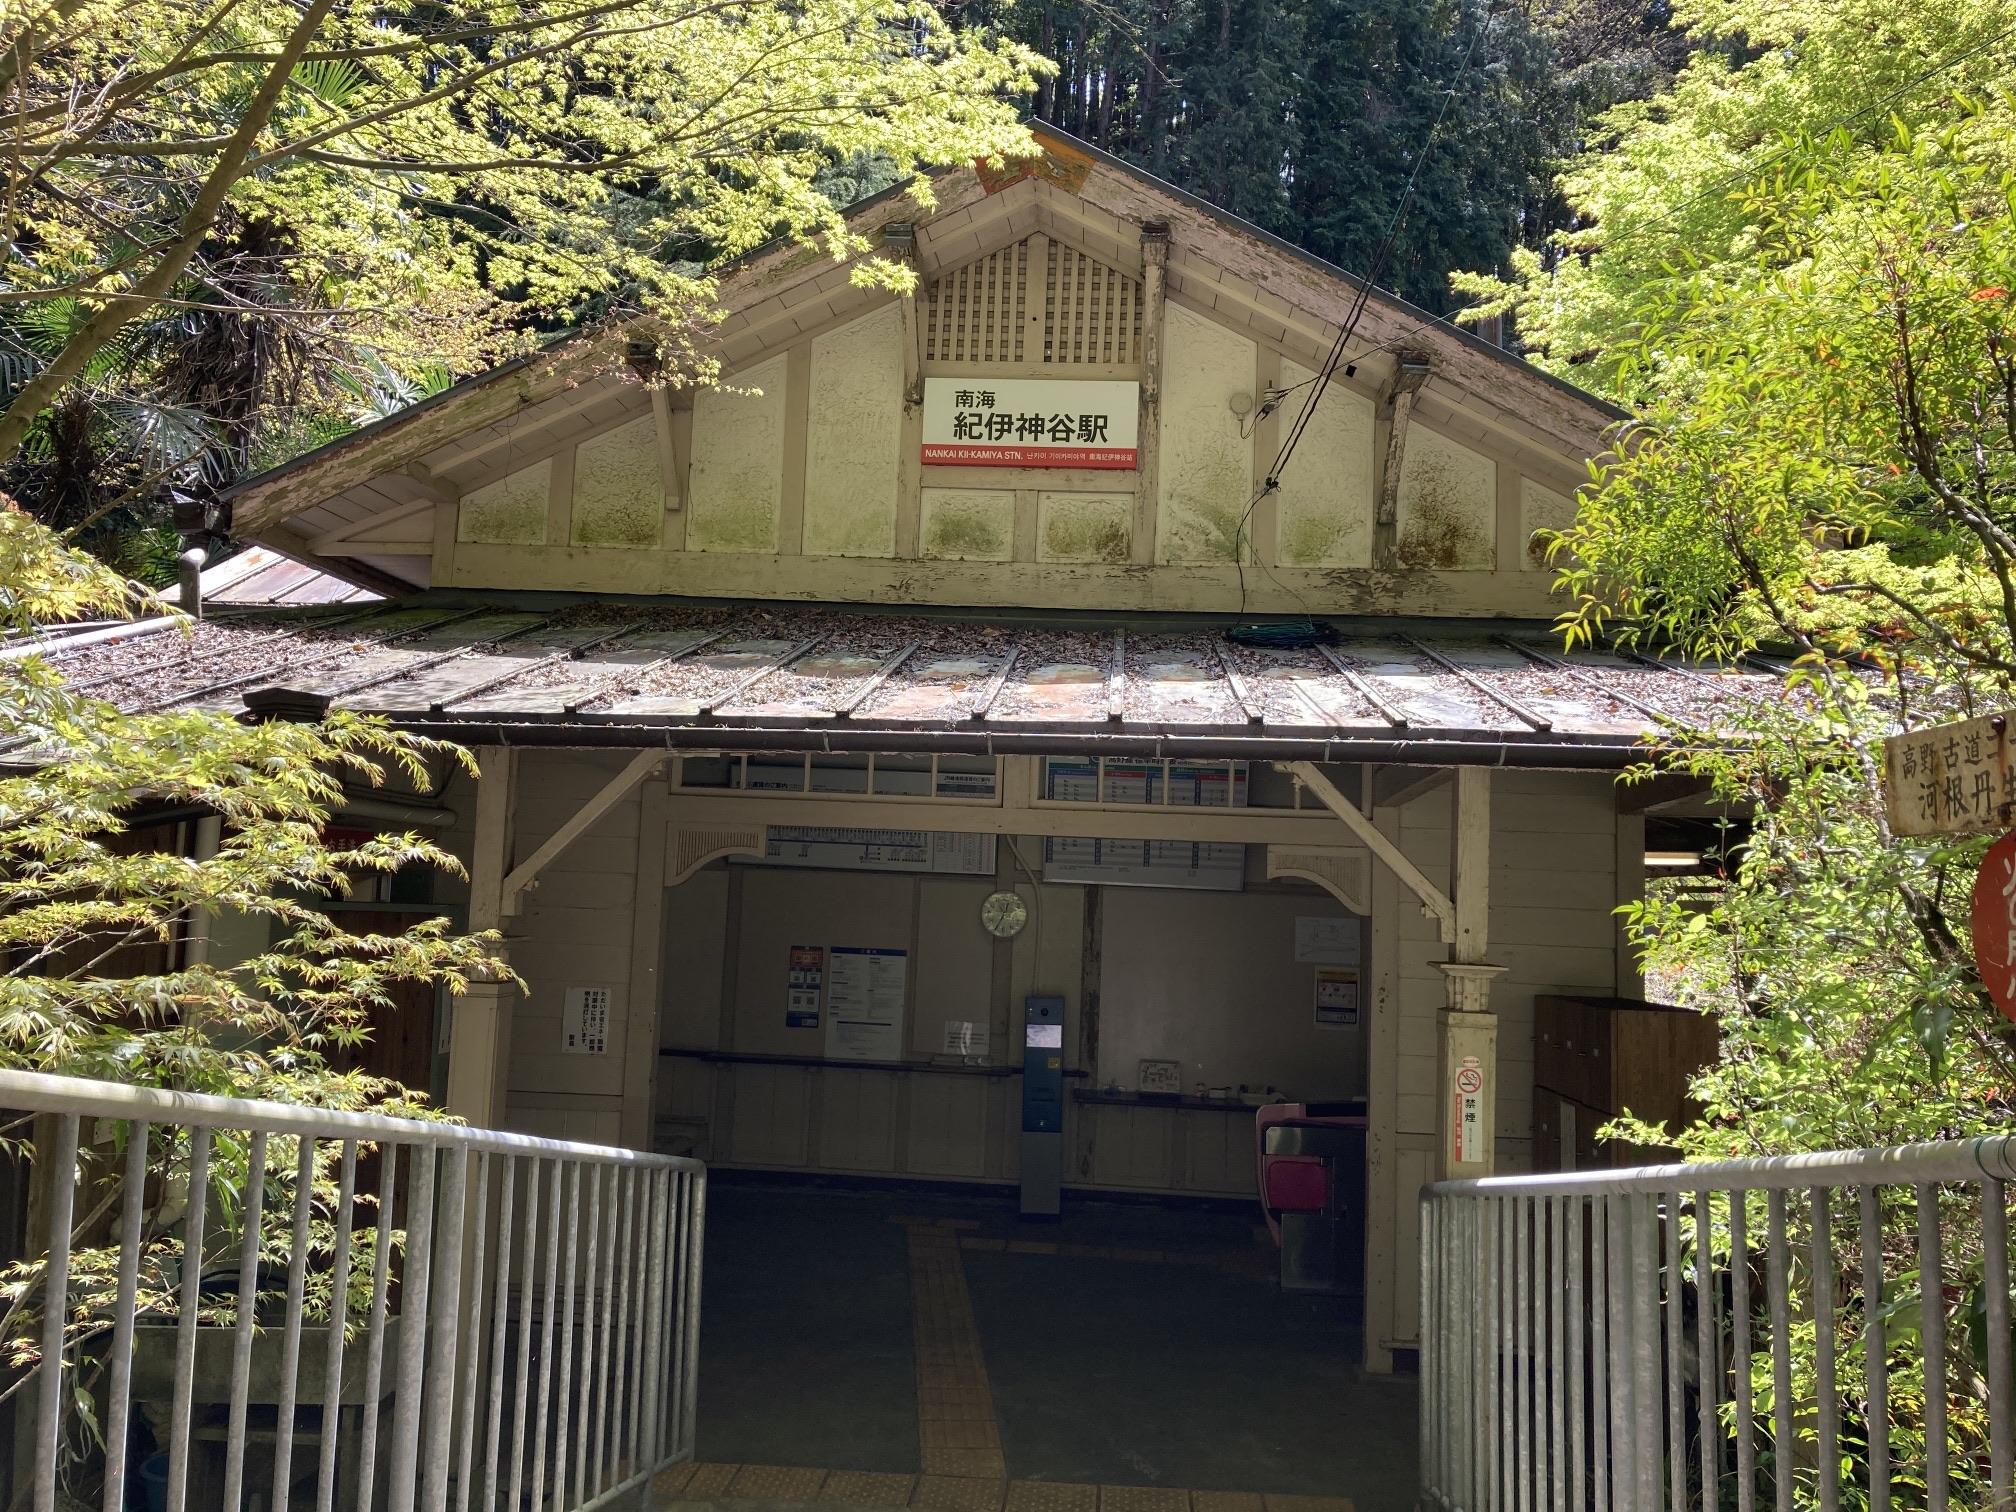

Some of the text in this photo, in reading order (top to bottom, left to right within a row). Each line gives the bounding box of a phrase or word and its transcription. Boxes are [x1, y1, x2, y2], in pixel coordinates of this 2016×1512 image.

[955, 390, 996, 409] 南海
[953, 412, 1109, 443] 紀伊神谷駅
[925, 449, 1024, 460] NANKAI KII-KAMIYA STN.
[1465, 1098, 1477, 1123] 禁煙
